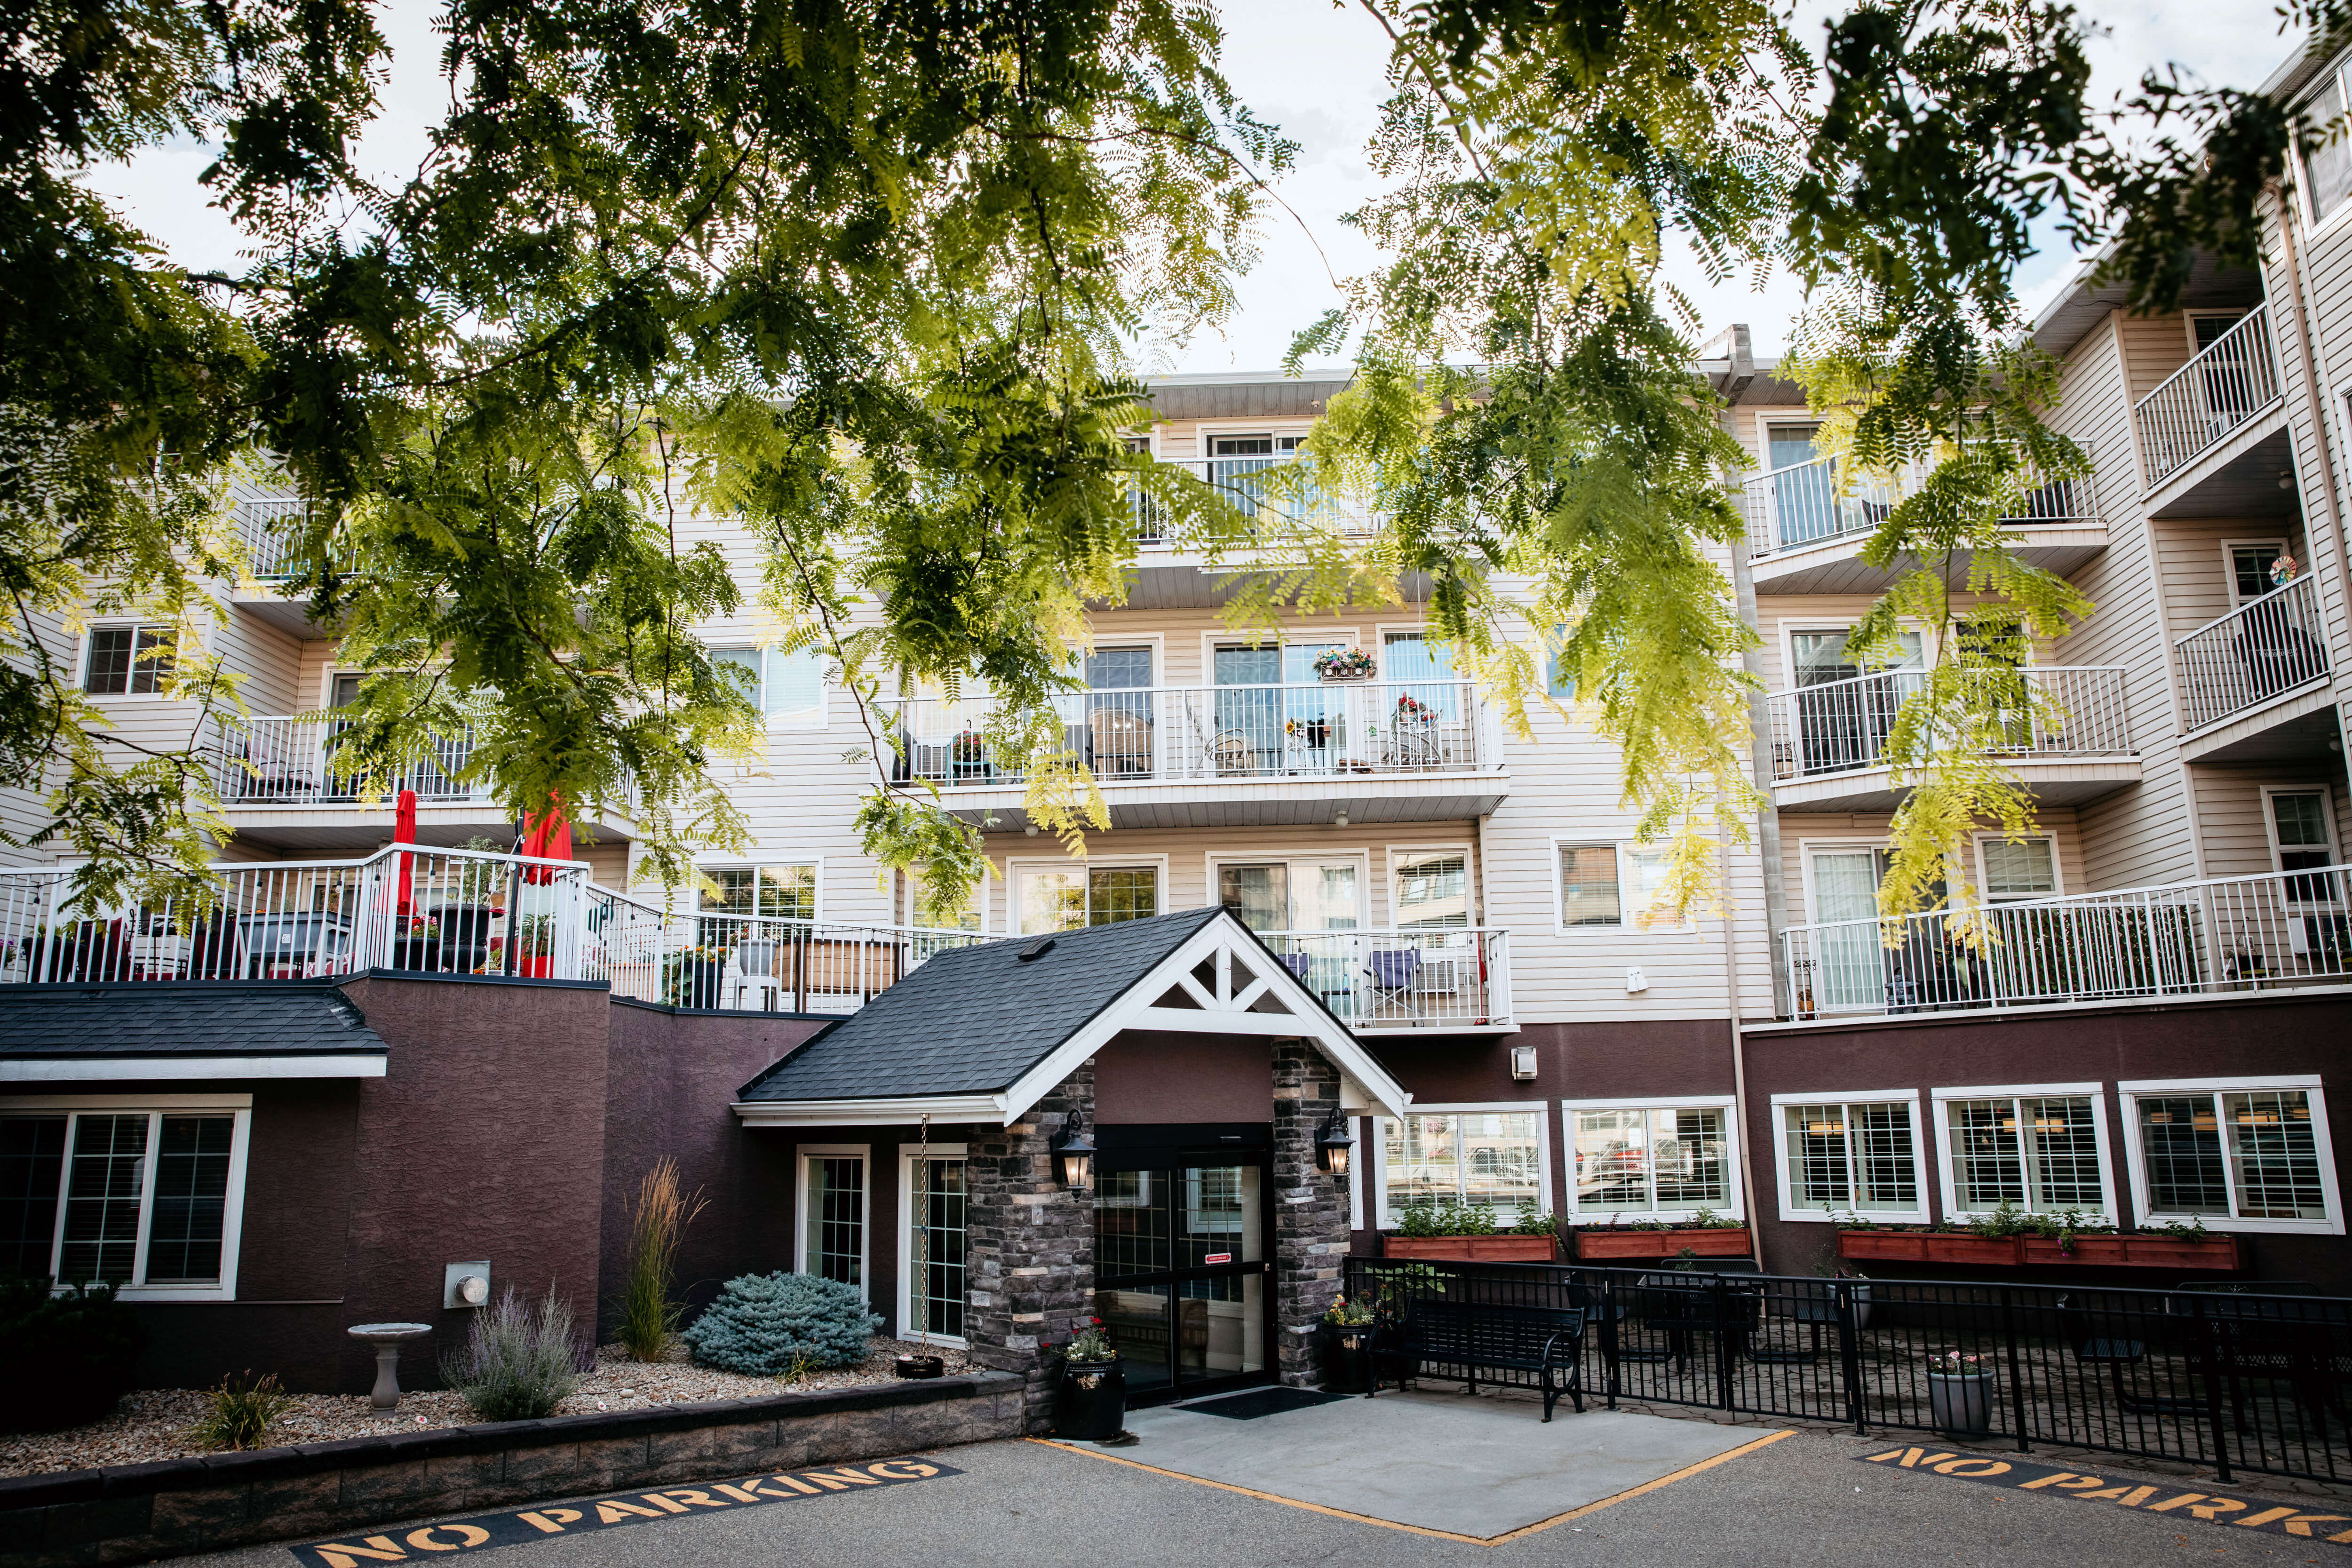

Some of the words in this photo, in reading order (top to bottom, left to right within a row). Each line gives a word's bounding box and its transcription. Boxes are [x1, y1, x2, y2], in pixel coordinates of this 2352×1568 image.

[1865, 1447, 2012, 1476] NO
[314, 1525, 490, 1568] NO
[517, 1460, 939, 1533] PARKING
